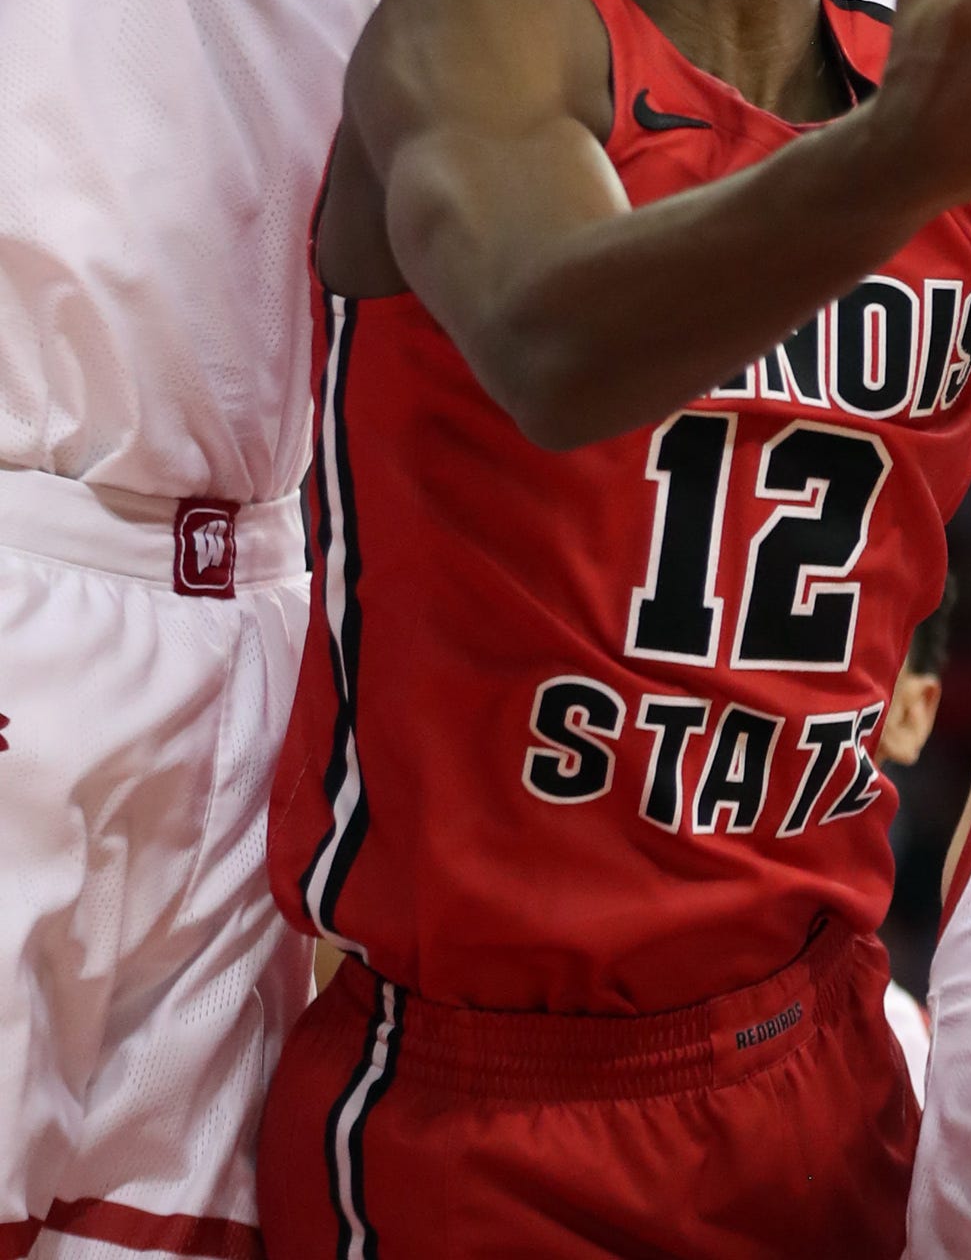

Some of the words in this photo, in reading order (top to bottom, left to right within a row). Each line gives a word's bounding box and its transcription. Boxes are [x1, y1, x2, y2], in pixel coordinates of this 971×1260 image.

[624, 411, 892, 671] 12
[522, 674, 885, 839] STATE
[735, 1001, 803, 1050] REDBIRDS
